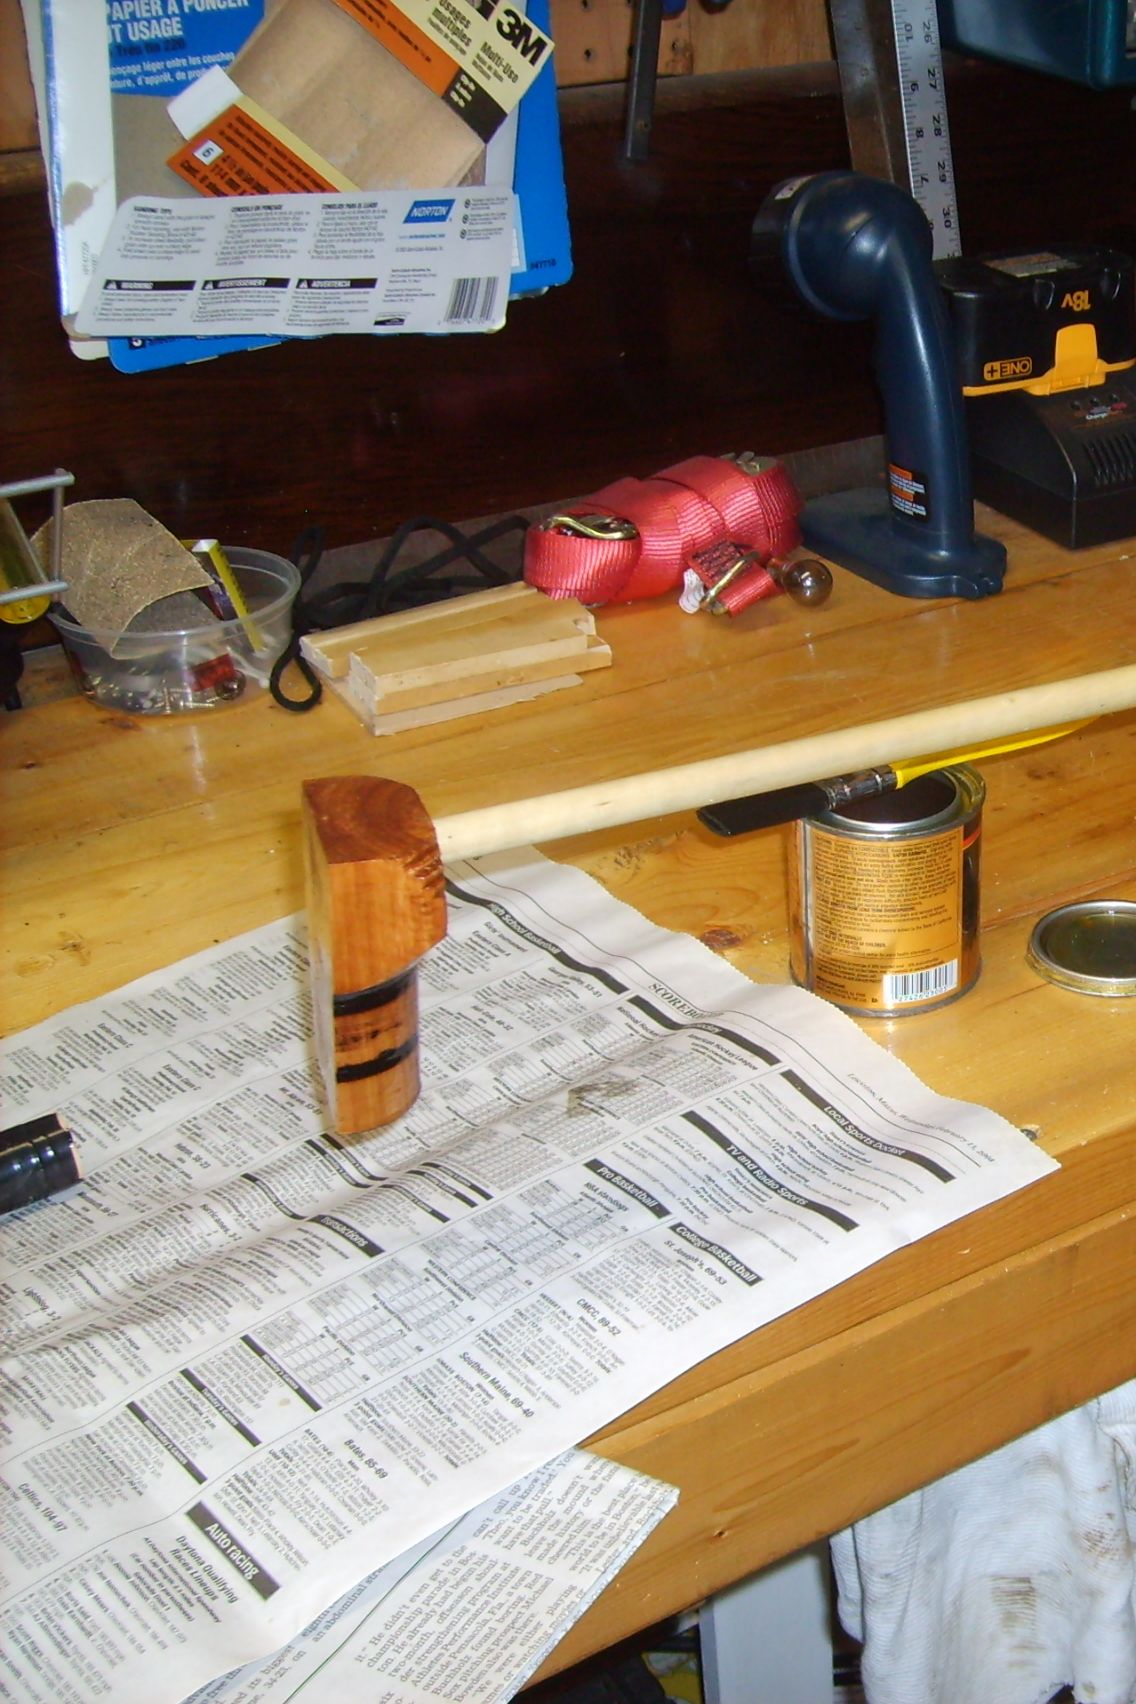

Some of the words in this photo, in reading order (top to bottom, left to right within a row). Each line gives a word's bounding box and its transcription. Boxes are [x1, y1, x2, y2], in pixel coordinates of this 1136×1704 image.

[127, 17, 183, 41] USAGE
[496, 8, 548, 67] 3M
[922, 22, 934, 43] 26
[927, 67, 938, 90] 27
[932, 114, 942, 137] 28
[937, 161, 946, 183] 29
[410, 205, 450, 219] NORTON
[942, 207, 951, 229] 30
[1061, 289, 1091, 312] 18V
[500, 913, 528, 935] School
[712, 1043, 737, 1059] Hockey
[734, 1055, 759, 1071] League
[821, 1104, 850, 1126] Local
[843, 1122, 876, 1146] Sports
[595, 1165, 615, 1180] Pro
[610, 1173, 658, 1210] Basketball
[725, 1144, 742, 1158] TV
[736, 1154, 758, 1171] and
[752, 1167, 781, 1190] Radio
[775, 1183, 809, 1209] Sports
[322, 1215, 367, 1248] Transactions
[674, 1223, 711, 1252] College
[707, 1243, 757, 1283] Basketball
[703, 1266, 728, 1286] 69-53
[575, 1298, 601, 1319] CMCC,
[597, 1316, 621, 1337] 89-52
[460, 1351, 491, 1381] Southern
[489, 1376, 512, 1402] Maine,
[511, 1397, 535, 1418] 69-40
[343, 1438, 368, 1460] Bates,
[363, 1457, 388, 1479] 85-69
[19, 1482, 42, 1510] Celtics,
[42, 1507, 68, 1532] 104-97
[516, 1476, 541, 1500] know
[559, 1483, 592, 1514] mound
[600, 1498, 620, 1516] best
[615, 1477, 638, 1498] place
[471, 1516, 493, 1537] can't
[491, 1498, 510, 1514] call
[519, 1509, 557, 1547] Buchholz
[553, 1474, 585, 1505] doesn't
[203, 1521, 235, 1549] Auto
[222, 1544, 262, 1579] racing
[503, 1529, 525, 1550] have
[519, 1513, 538, 1531] that
[535, 1538, 559, 1561] made
[554, 1509, 585, 1538] history
[545, 1533, 578, 1565] cheered
[167, 1547, 194, 1572] Races
[187, 1569, 221, 1601] Lineups
[173, 1534, 207, 1567] Daytona
[199, 1563, 241, 1604] Qualifying
[567, 1547, 593, 1572] world
[318, 1580, 370, 1633] abdominal
[368, 1631, 385, 1646] He
[382, 1603, 410, 1630] didn't
[407, 1581, 431, 1603] even
[450, 1542, 467, 1558] the
[404, 1607, 439, 1641] already
[433, 1590, 453, 1608] had
[450, 1565, 478, 1591] begun
[472, 1551, 489, 1566] his
[433, 1584, 474, 1624] offseason
[364, 1606, 425, 1668] championship
[420, 1576, 452, 1606] parade
[409, 1650, 446, 1686] Athletes
[440, 1599, 493, 1651] Performance
[487, 1564, 522, 1599] Institute
[412, 1605, 472, 1666] strengthening
[467, 1570, 503, 1605] program
[419, 1659, 453, 1691] outside
[448, 1613, 494, 1659] Pensacola,
[509, 1568, 533, 1590] town
[429, 1653, 473, 1696] Buchholz
[469, 1625, 497, 1652] found
[524, 1572, 544, 1590] Red
[441, 1680, 462, 1700] Sox
[457, 1643, 497, 1681] pitching
[489, 1609, 527, 1646] prospect
[520, 1575, 555, 1610] Michael
[259, 1641, 297, 1679] biggest
[452, 1667, 489, 1703] Bowden
[483, 1649, 504, 1668] also
